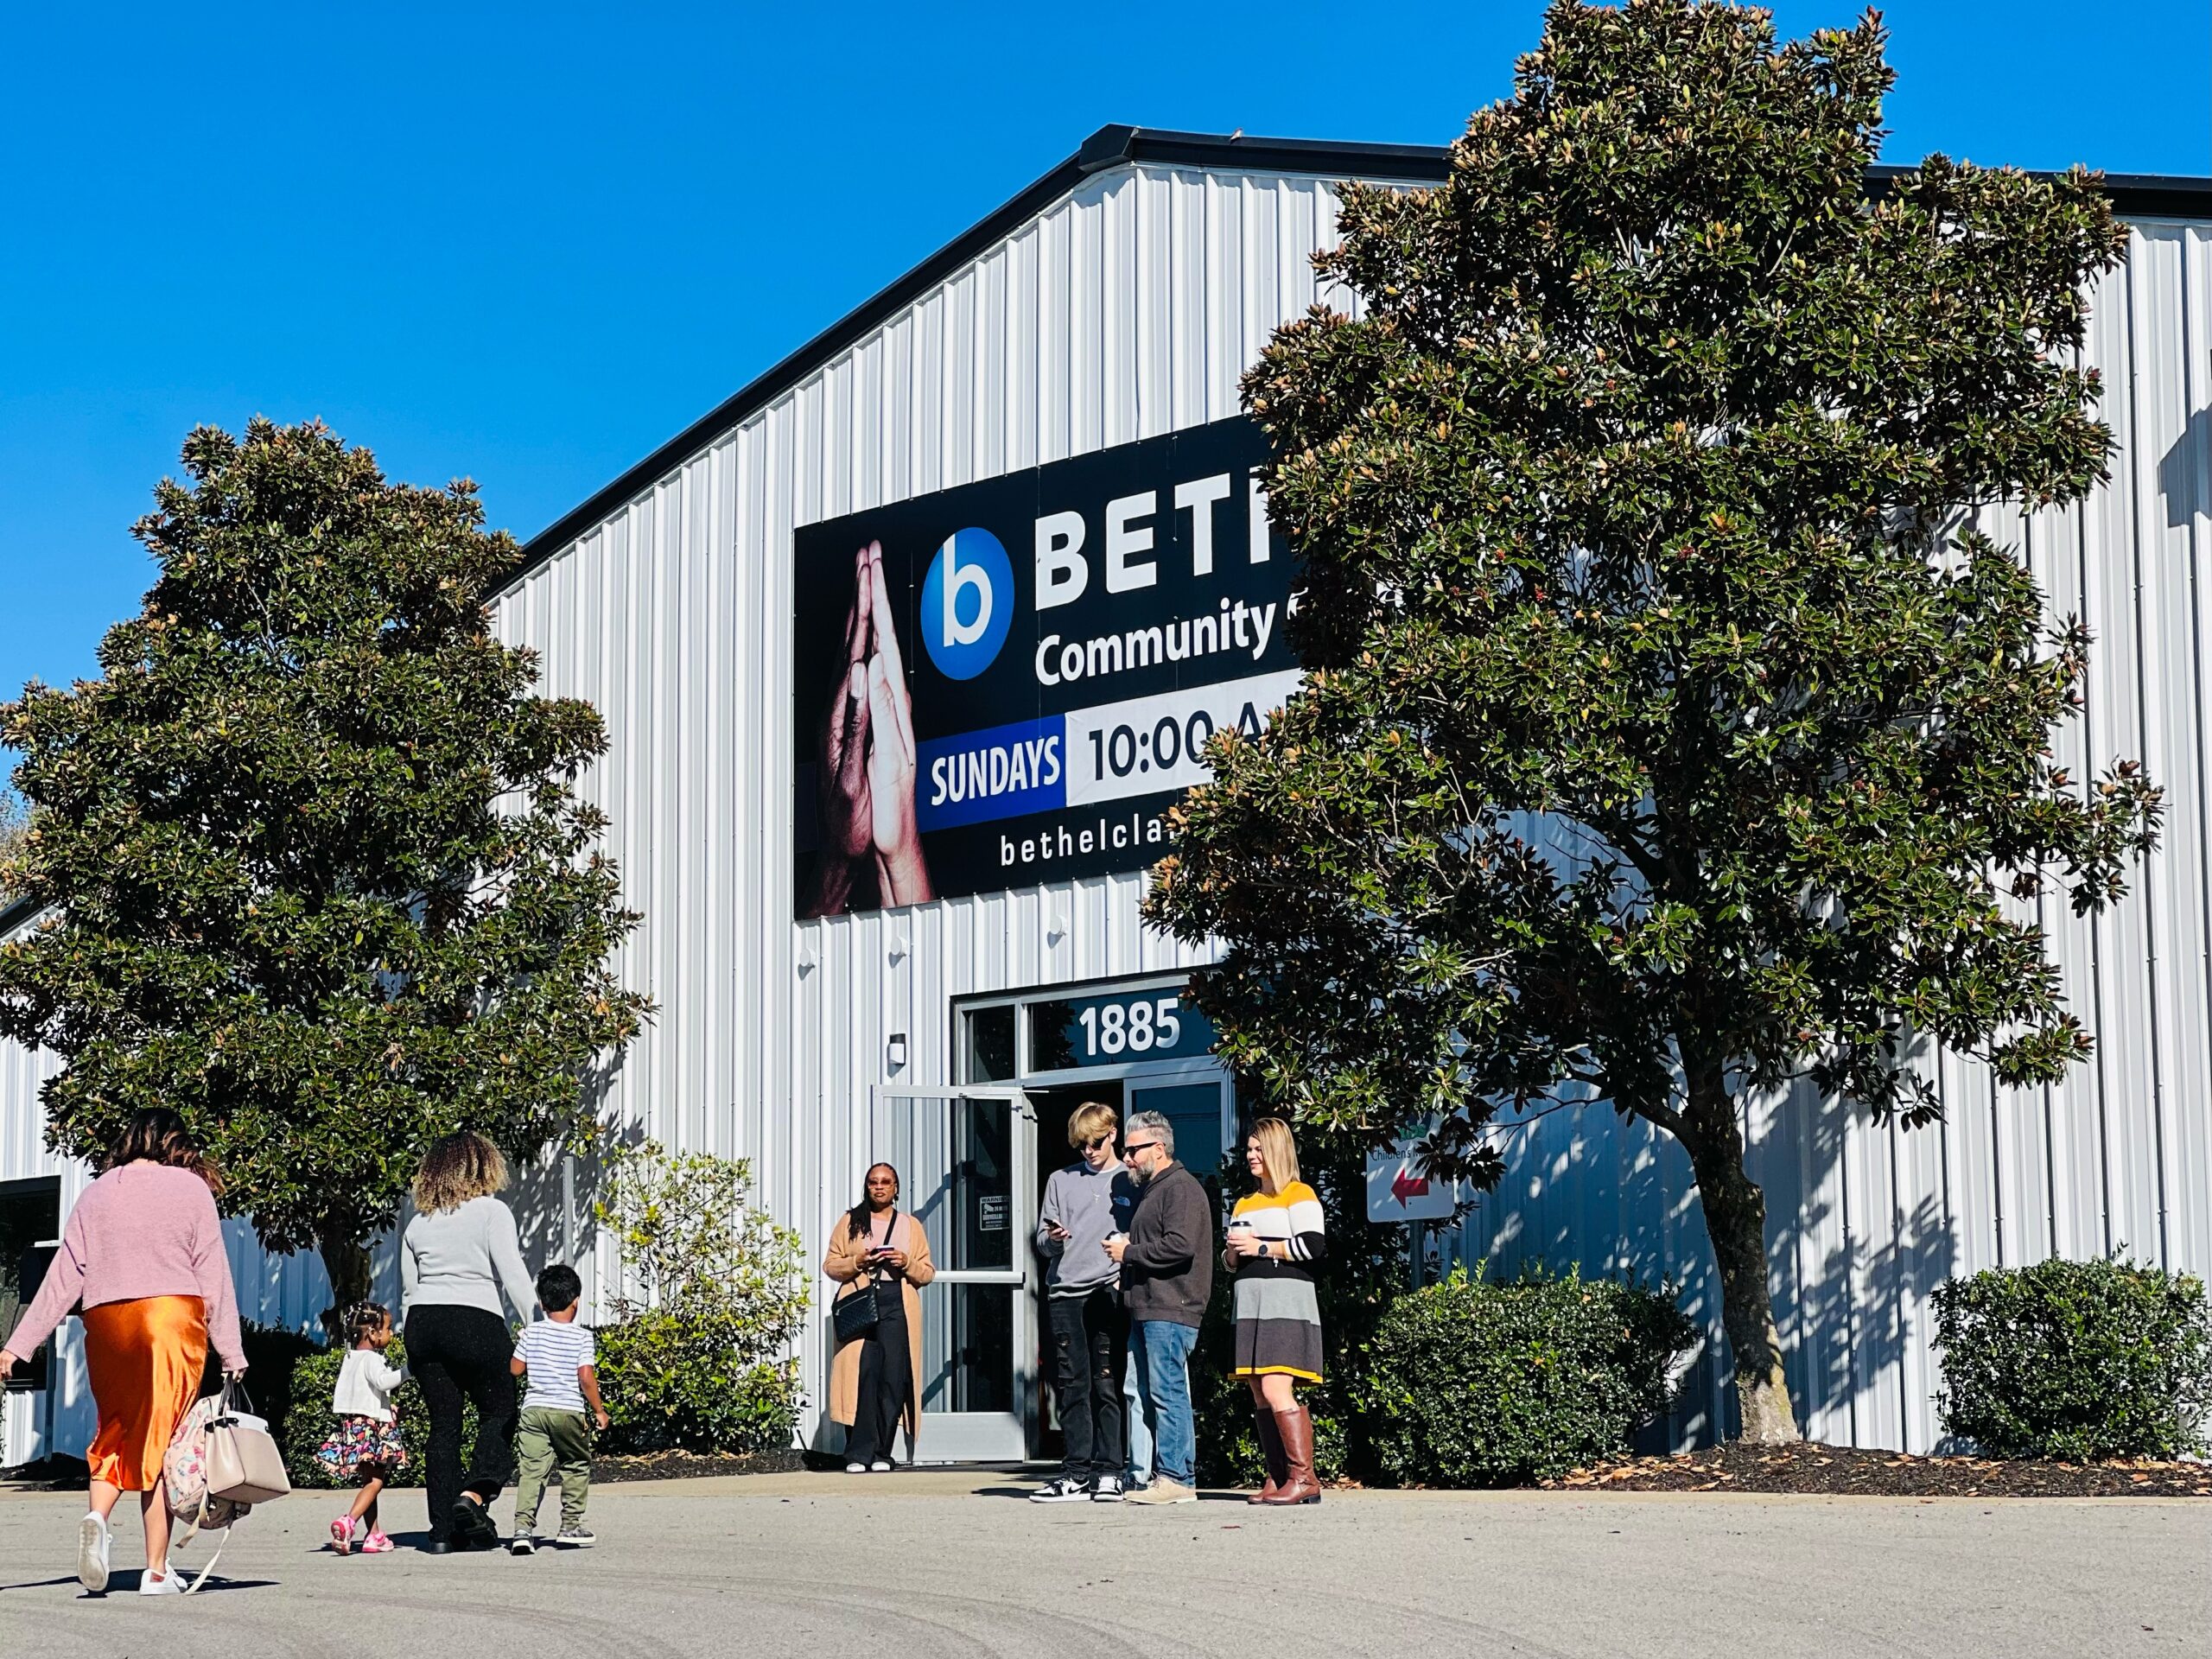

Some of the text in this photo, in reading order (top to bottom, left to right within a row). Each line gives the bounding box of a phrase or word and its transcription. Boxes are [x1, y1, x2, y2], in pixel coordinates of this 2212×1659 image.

[1035, 596, 1277, 686] Community
[931, 734, 1061, 807] SUNDAYS
[1089, 709, 1215, 782] 10:00
[1078, 997, 1181, 1057] 1885
